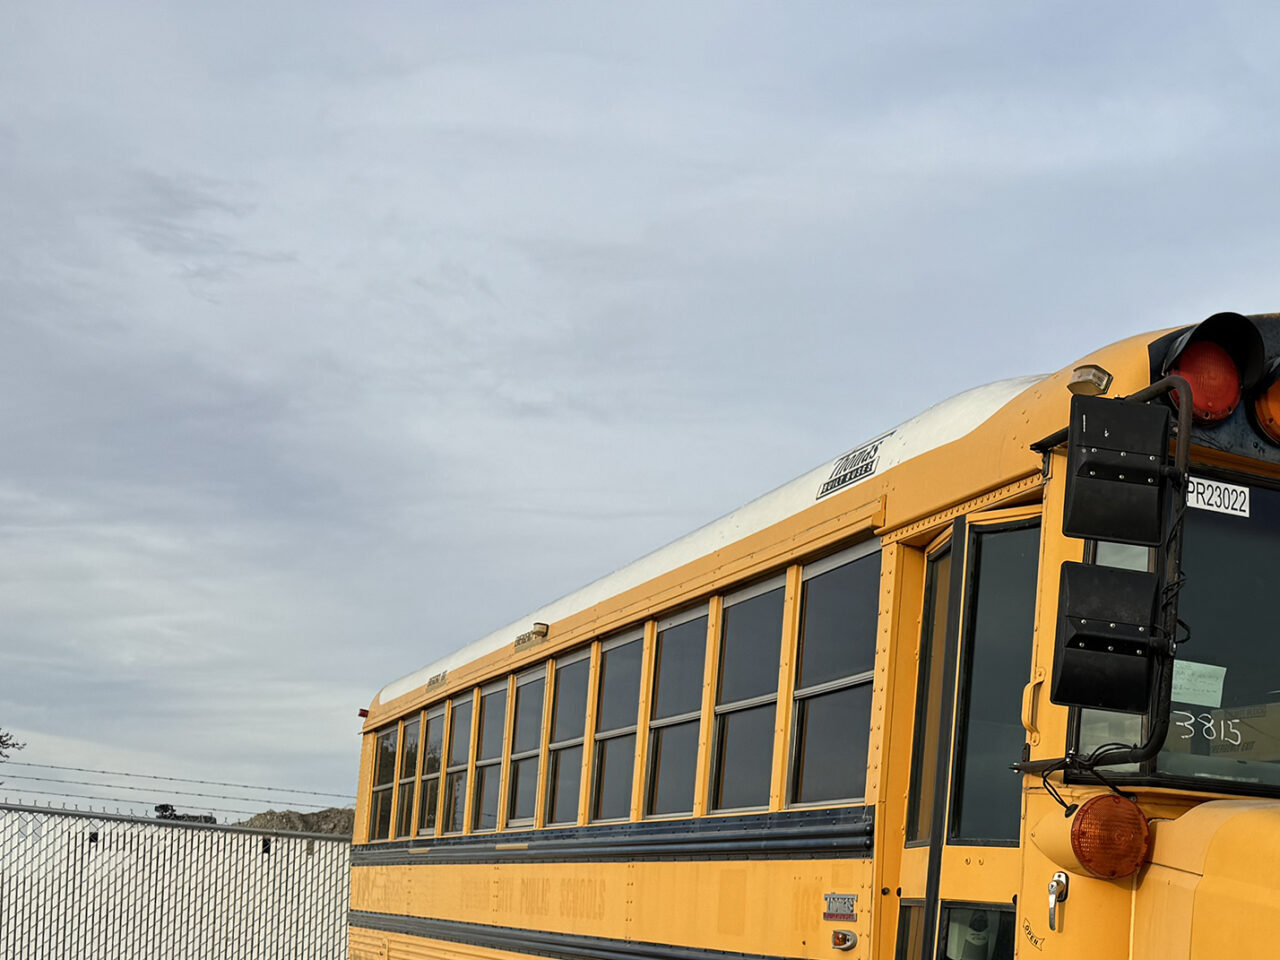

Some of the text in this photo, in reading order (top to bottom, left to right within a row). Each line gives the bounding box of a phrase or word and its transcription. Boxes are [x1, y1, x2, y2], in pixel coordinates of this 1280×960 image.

[1186, 480, 1247, 513] PR23022
[1173, 710, 1241, 745] 3815
[1024, 924, 1039, 946] OPEN
